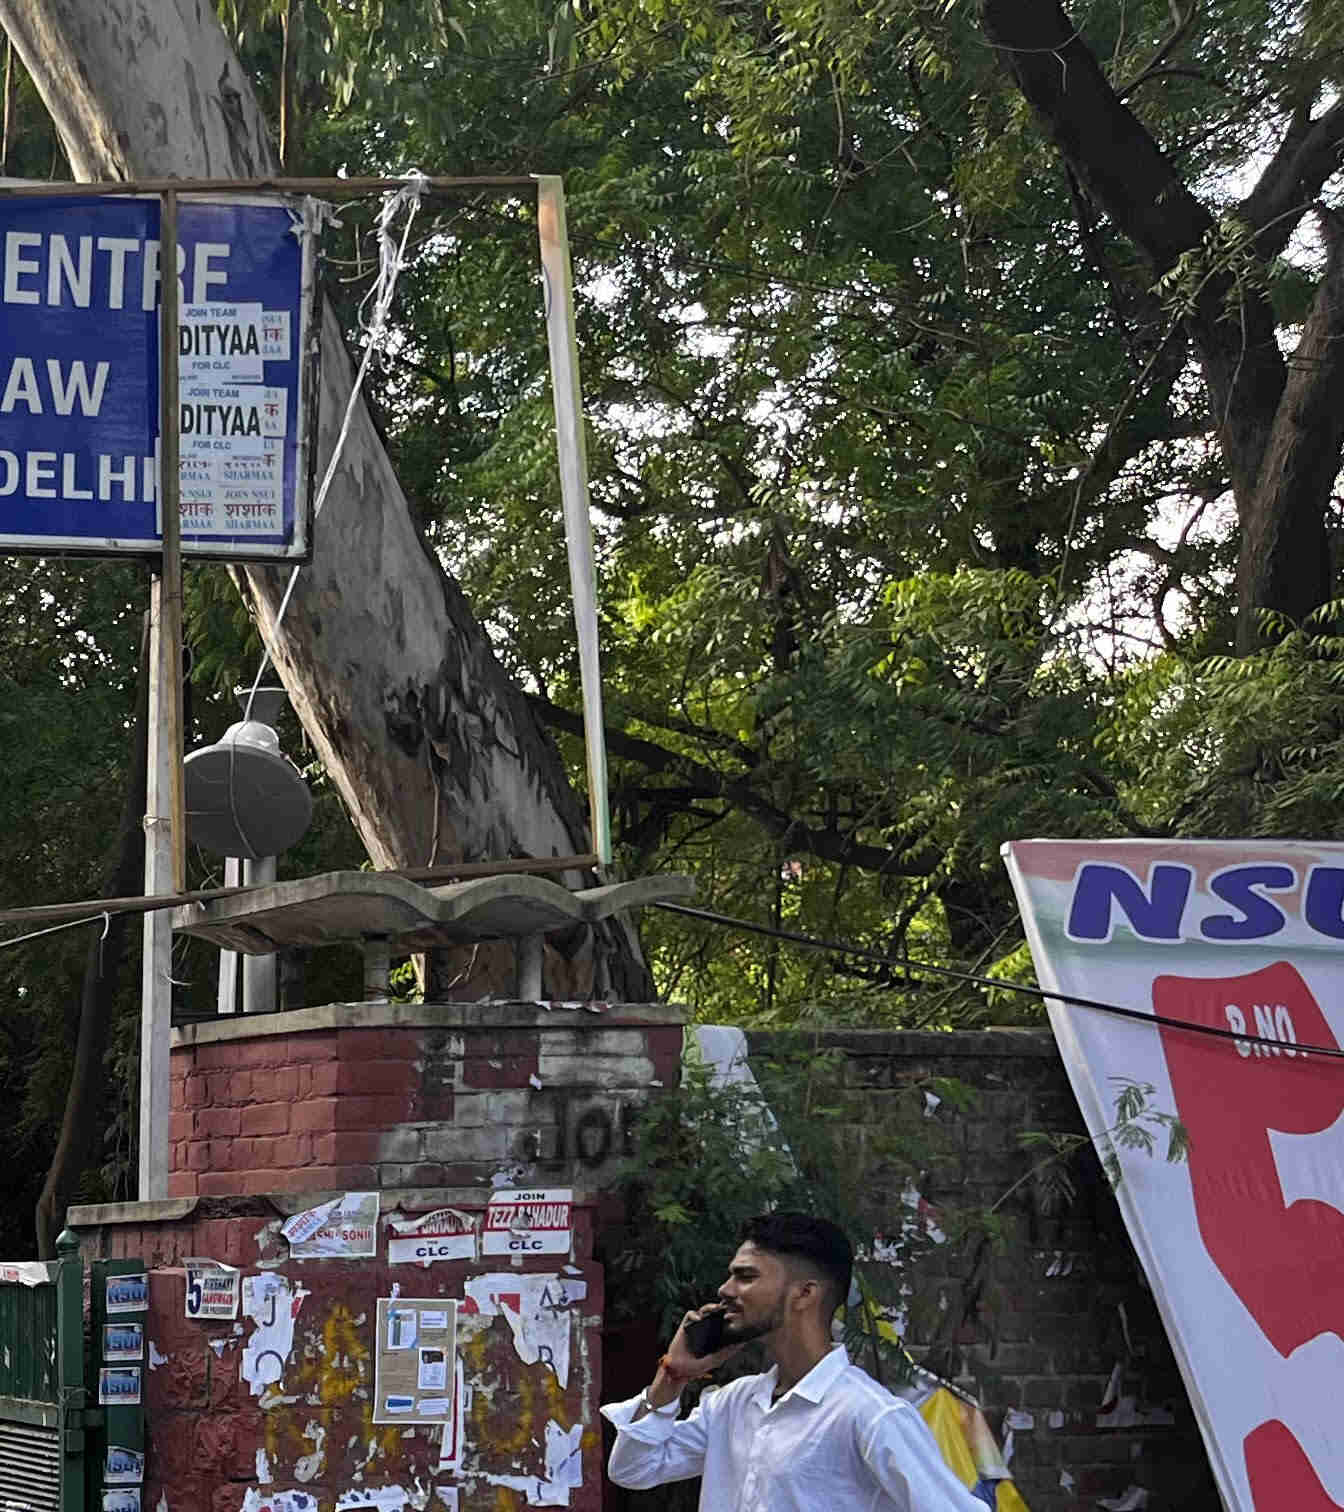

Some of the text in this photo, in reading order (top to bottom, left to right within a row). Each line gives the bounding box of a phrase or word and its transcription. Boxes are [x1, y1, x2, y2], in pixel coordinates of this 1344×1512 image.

[185, 308, 238, 318] JOIN TEAM
[213, 361, 231, 370] CLC
[188, 388, 240, 399] JOIN TEAM
[213, 441, 232, 450] CLC
[513, 1192, 545, 1201] JOIN
[508, 1239, 544, 1251] CLC
[415, 1246, 450, 1257] CLC
